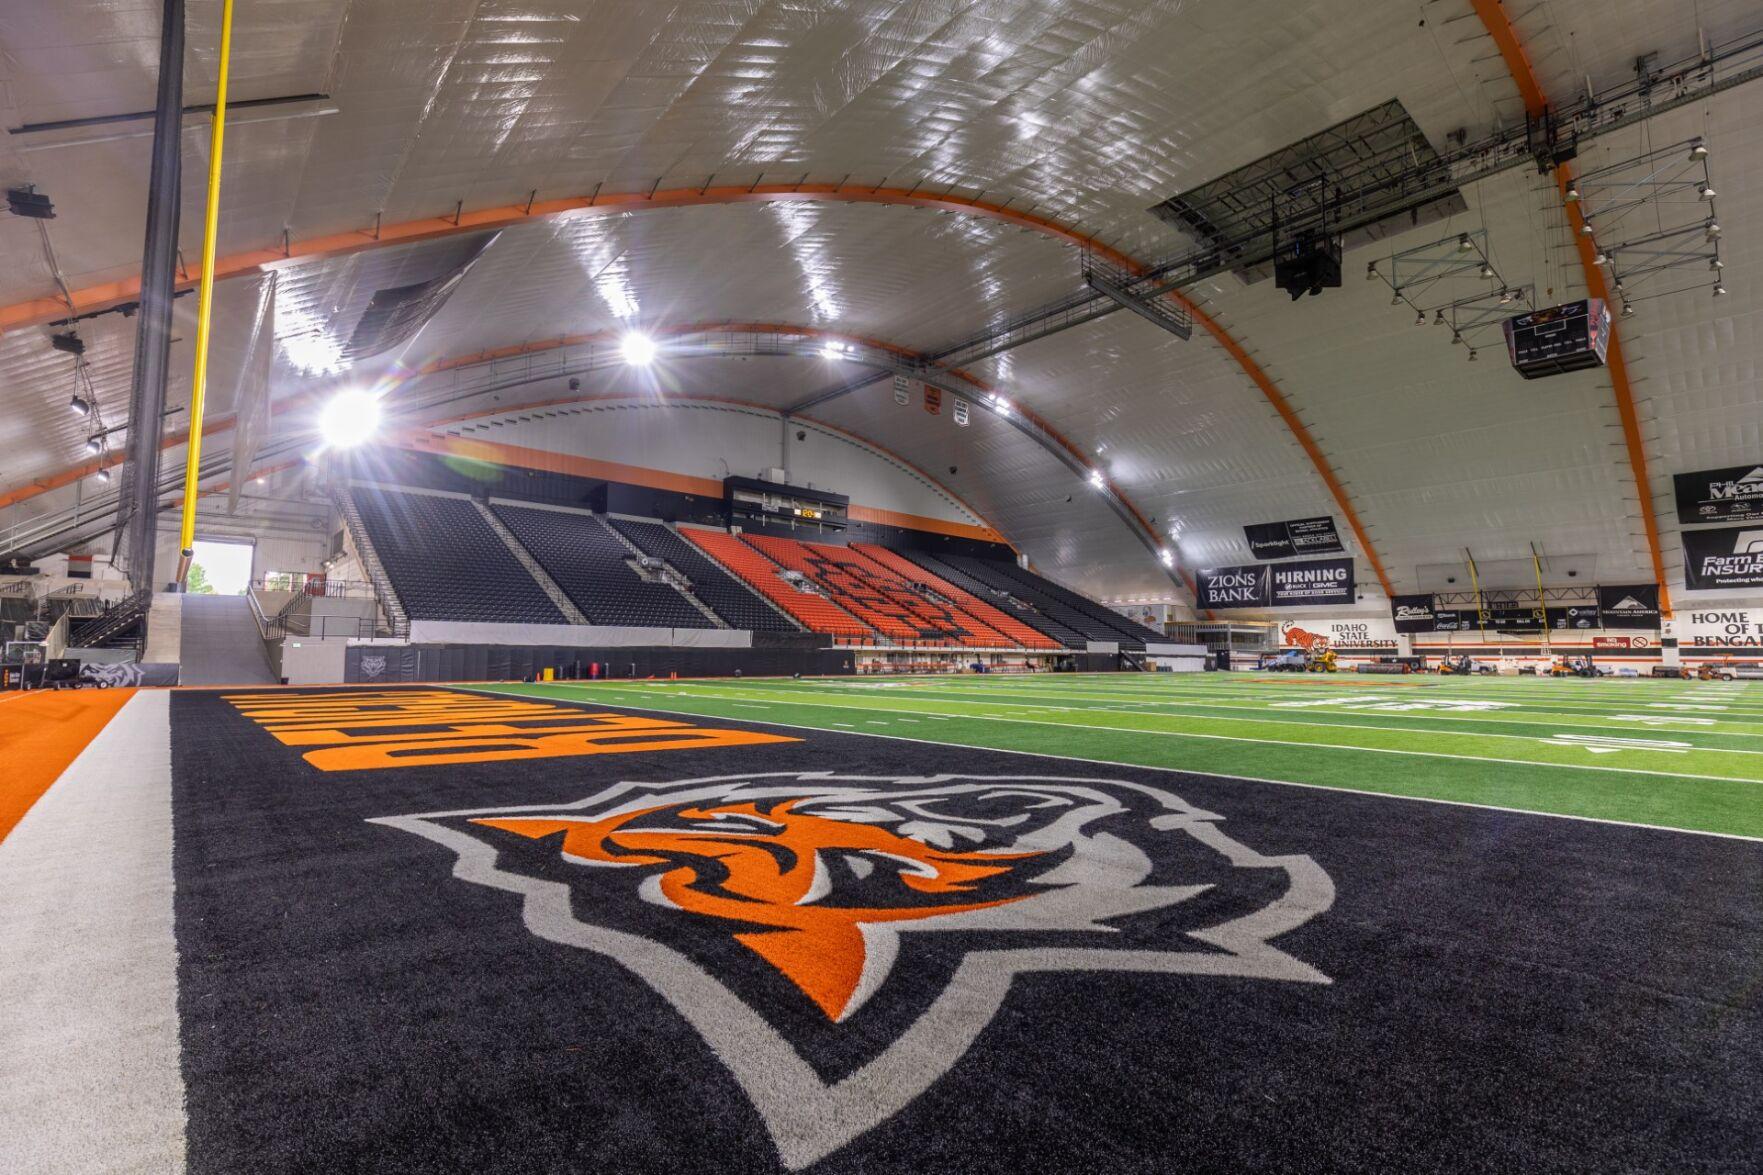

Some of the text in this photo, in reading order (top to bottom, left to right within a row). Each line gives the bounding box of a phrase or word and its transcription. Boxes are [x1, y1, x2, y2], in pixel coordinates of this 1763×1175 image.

[1710, 483, 1763, 500] Mea
[1703, 555, 1751, 566] Farm
[1208, 573, 1256, 589] ZIONS
[1275, 568, 1347, 584] HIRNING
[1692, 612, 1749, 624] HOME
[1331, 623, 1368, 632] IDAHO
[1725, 624, 1749, 634] OF
[1339, 632, 1370, 640] STATE
[1334, 640, 1398, 648] UNIVERSITY
